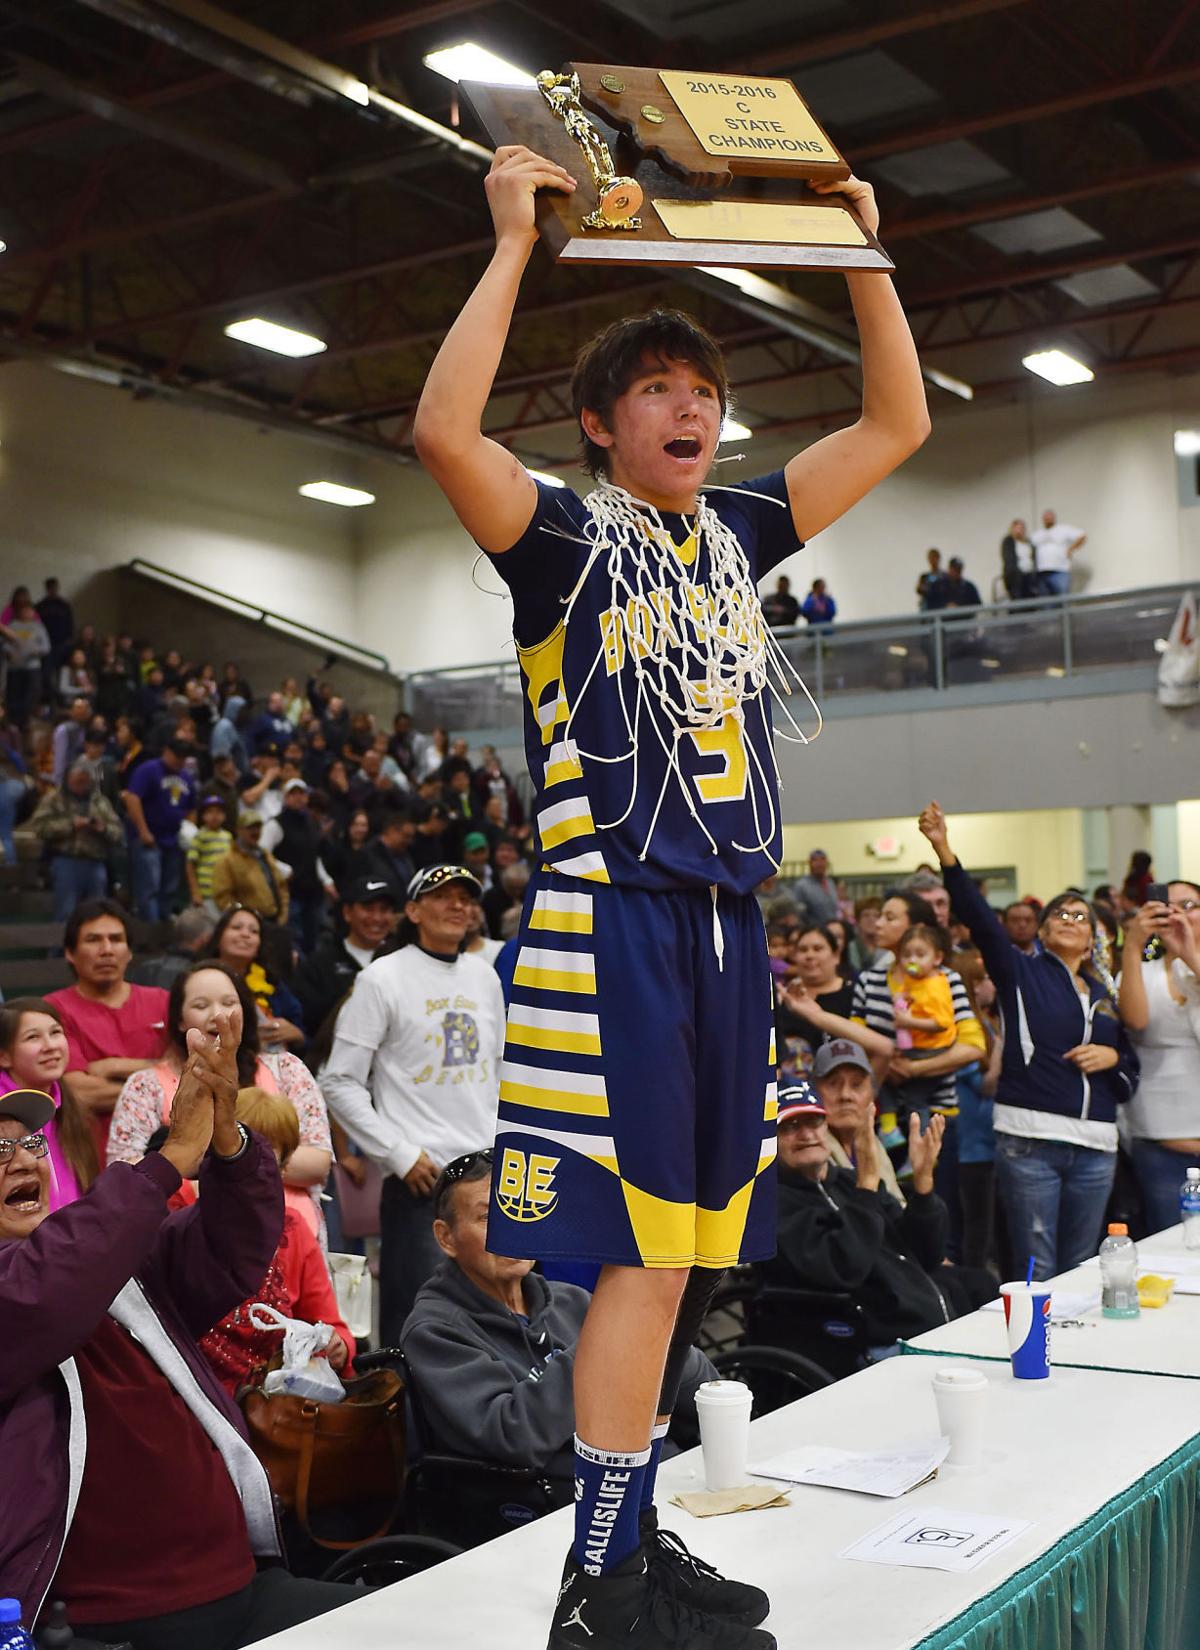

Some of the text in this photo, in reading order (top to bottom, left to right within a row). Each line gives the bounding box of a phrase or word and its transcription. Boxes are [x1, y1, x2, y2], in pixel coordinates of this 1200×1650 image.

[686, 81, 777, 99] 2015-2016
[736, 101, 752, 114] C
[724, 117, 785, 133] STATE
[708, 134, 824, 153] CHAMPIONS
[499, 1148, 561, 1205] BE
[583, 1470, 631, 1577] BALLISLIFE
